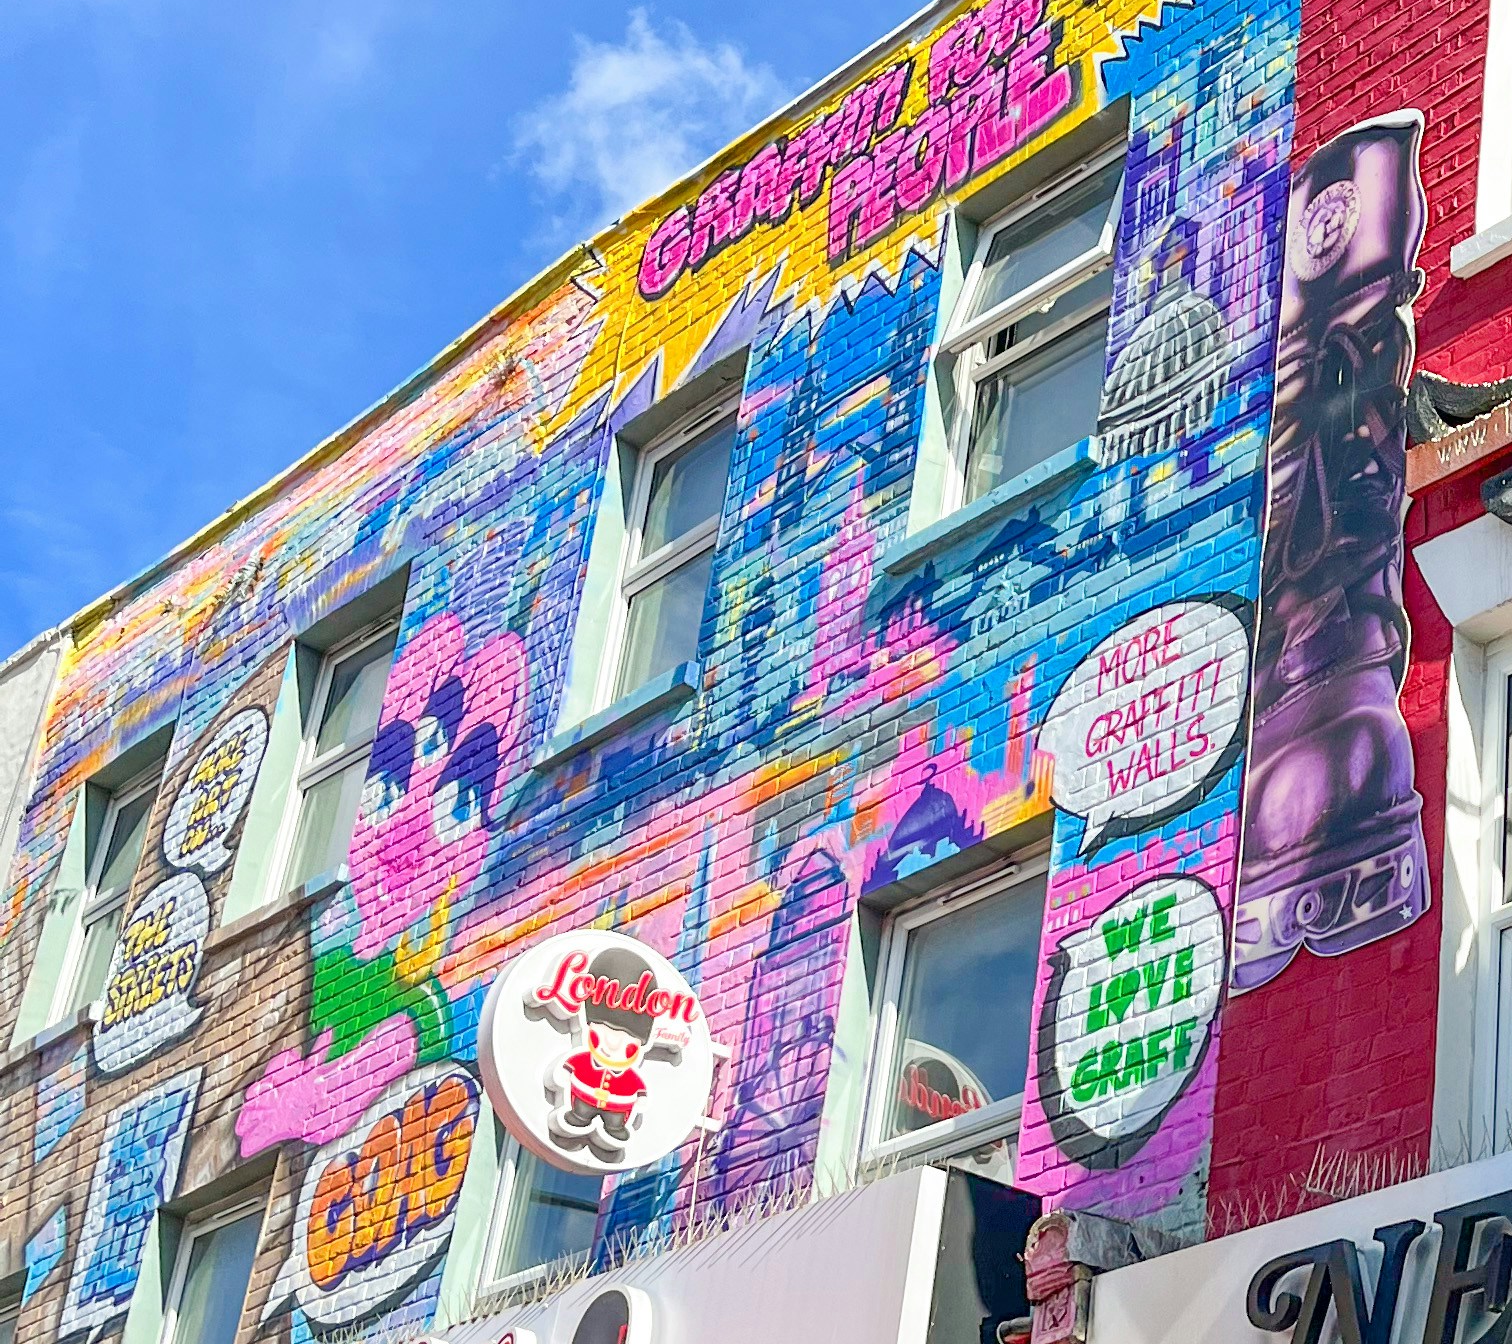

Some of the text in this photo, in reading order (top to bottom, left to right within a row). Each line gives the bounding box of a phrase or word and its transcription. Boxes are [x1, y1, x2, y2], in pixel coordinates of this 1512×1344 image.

[638, 61, 914, 301] GRAFFITI
[826, 16, 1082, 266] PEOPLE
[1096, 610, 1184, 695] MORE
[1084, 656, 1223, 757] GRAFFITI
[1105, 722, 1216, 799] WALLS.
[1102, 892, 1178, 962] WE
[535, 949, 700, 1024] London
[1085, 945, 1196, 1034] LOVE
[655, 1027, 691, 1048] Family
[1069, 1020, 1193, 1104] GRAFF
